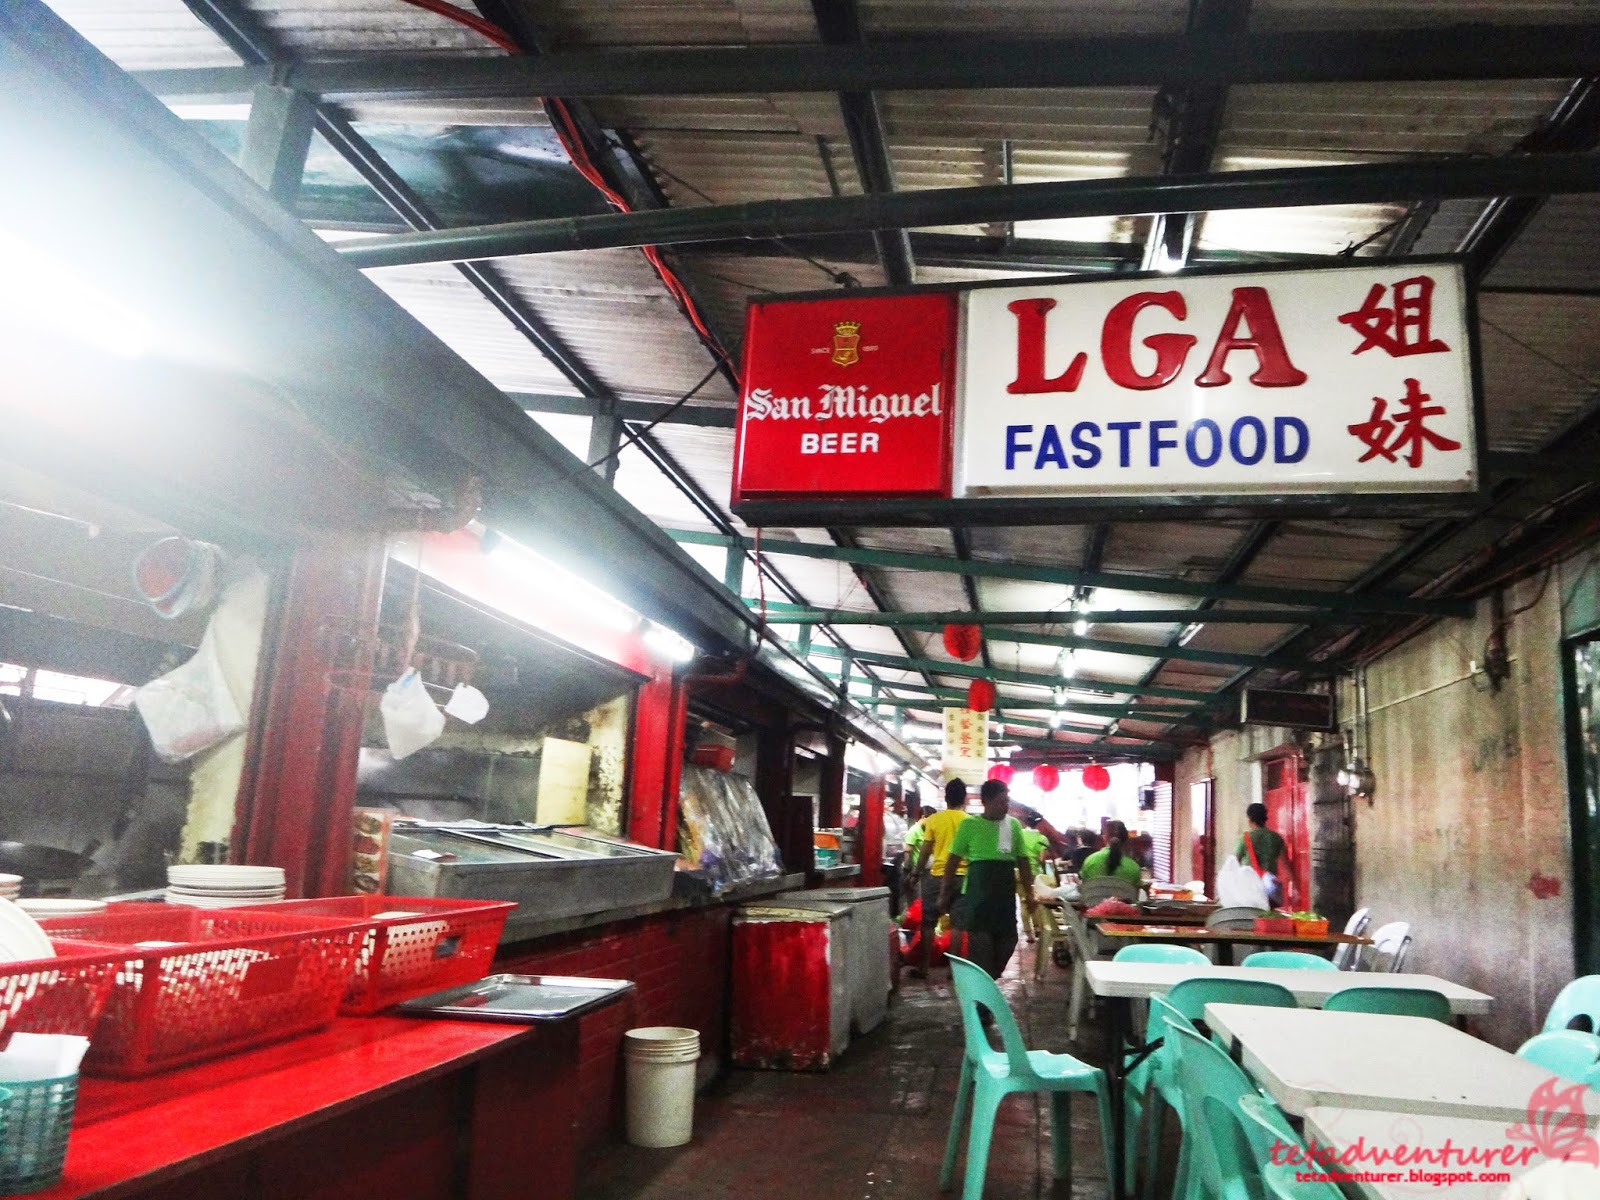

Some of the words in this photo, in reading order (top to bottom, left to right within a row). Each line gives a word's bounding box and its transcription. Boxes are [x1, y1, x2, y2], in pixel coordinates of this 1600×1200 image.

[1007, 287, 1307, 394] LGA
[1338, 275, 1461, 468] 姐妹
[746, 387, 812, 421] San
[814, 382, 943, 424] Miguel
[801, 432, 880, 455] BEER
[1005, 416, 1310, 470] FASTFOOD
